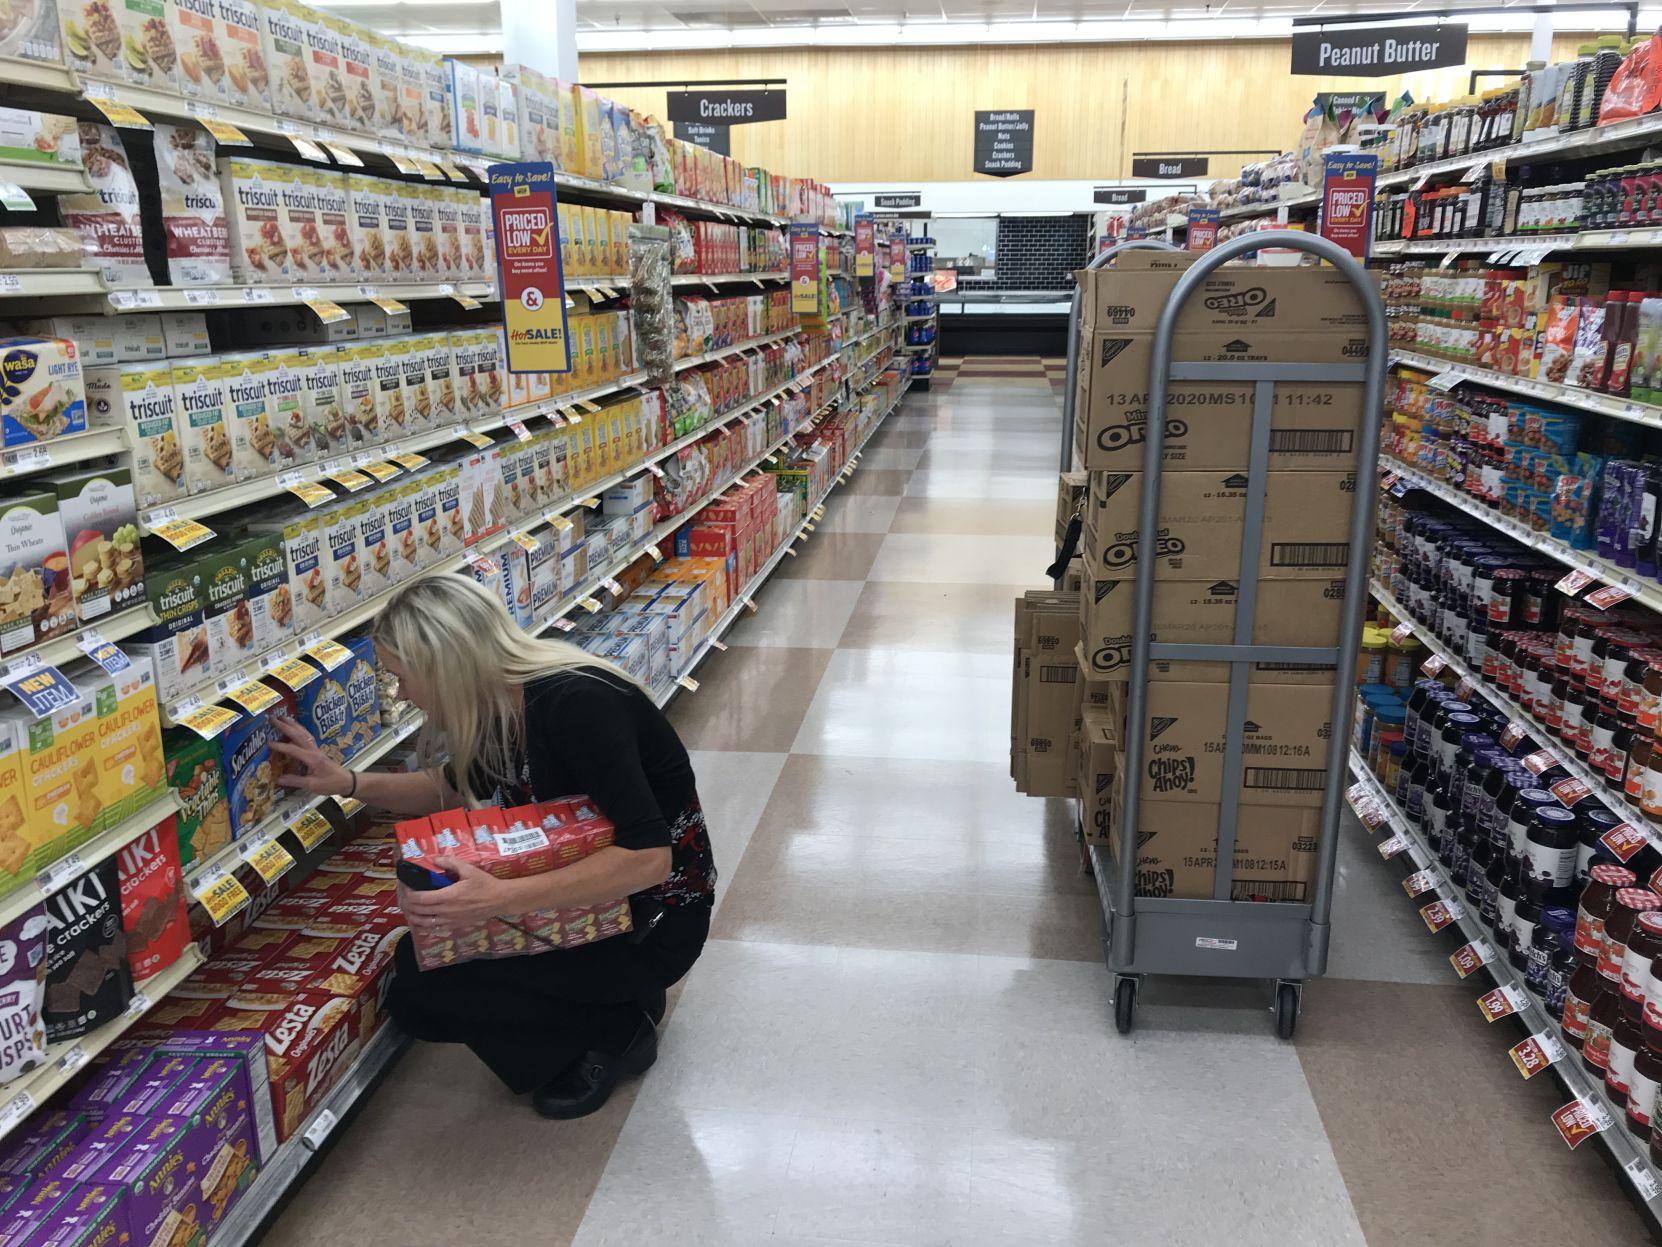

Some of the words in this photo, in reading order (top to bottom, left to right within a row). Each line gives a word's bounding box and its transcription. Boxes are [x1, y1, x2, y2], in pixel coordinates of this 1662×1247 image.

[219, 4, 259, 32] triscuit
[268, 16, 303, 44] triscuit
[306, 30, 340, 56] triscuit
[1319, 42, 1380, 67] Peanut
[1384, 39, 1440, 63] Butter
[341, 44, 371, 66] triscuit
[700, 99, 753, 117] Crackers
[998, 132, 1010, 140] Nuts
[1159, 163, 1182, 175] Bread
[491, 174, 512, 190] Easy
[515, 174, 524, 184] to
[526, 172, 551, 183] Save!
[238, 186, 280, 207] triscuit
[282, 190, 317, 209] triscuit
[317, 194, 347, 213] triscuit
[1112, 193, 1128, 202] Bread
[1332, 192, 1364, 204] PRICED
[354, 198, 381, 217] triscuit
[384, 202, 408, 220] triscuit
[412, 206, 433, 221] triscuit
[438, 208, 458, 221] triscuit
[461, 210, 482, 224] triscuit
[1332, 204, 1351, 217] LOW
[506, 213, 546, 231] PRICED
[506, 232, 532, 248] LOW
[532, 246, 547, 254] DAY
[525, 292, 538, 307] &
[1204, 287, 1267, 310] OREO
[4, 356, 36, 371] wasa
[48, 363, 66, 376] LIGHT
[67, 362, 79, 373] RYE
[376, 361, 400, 380] triscuit
[402, 356, 425, 375] triscuit
[426, 351, 450, 369] triscuit
[267, 374, 301, 396] triscuit
[306, 370, 338, 391] triscuit
[342, 366, 372, 385] triscuit
[182, 388, 223, 412] triscuit
[229, 382, 266, 403] triscuit
[130, 394, 173, 420] triscuit
[415, 494, 436, 512] triscuit
[438, 484, 460, 502] triscuit
[360, 514, 386, 535] triscuit
[388, 504, 412, 525] triscuit
[328, 524, 356, 548] triscuit
[6, 542, 20, 553] Thin
[290, 538, 320, 562] triscuit
[531, 540, 555, 566] PREMIUM
[251, 556, 284, 581] triscuit
[209, 573, 244, 601] triscuit
[500, 552, 516, 616] REMIUM
[533, 580, 558, 607] PREMIUM
[160, 586, 195, 610] triscuit
[160, 608, 177, 622] THIN
[177, 600, 199, 615] CRISPS
[18, 672, 56, 694] NEW
[348, 673, 375, 700] Chicken
[32, 685, 76, 712] ITEM
[314, 693, 346, 720] Chicken
[98, 698, 155, 737] CAULIFLOWER
[320, 706, 346, 734] Biskit
[31, 732, 97, 774] CAULIFLOWER
[1148, 758, 1187, 779] Chips
[1153, 764, 1195, 792] Ahoy!
[120, 854, 167, 896] crackers
[56, 901, 110, 945] crackers
[1428, 906, 1445, 924] 2.39
[331, 932, 382, 974] Zesta
[1456, 951, 1474, 969] 1.09
[1485, 996, 1503, 1014] 1.99
[265, 1004, 316, 1056] Zesta
[306, 1022, 349, 1098] Zesta
[1518, 1047, 1539, 1070] 3.28
[149, 1149, 184, 1196] Annie's
